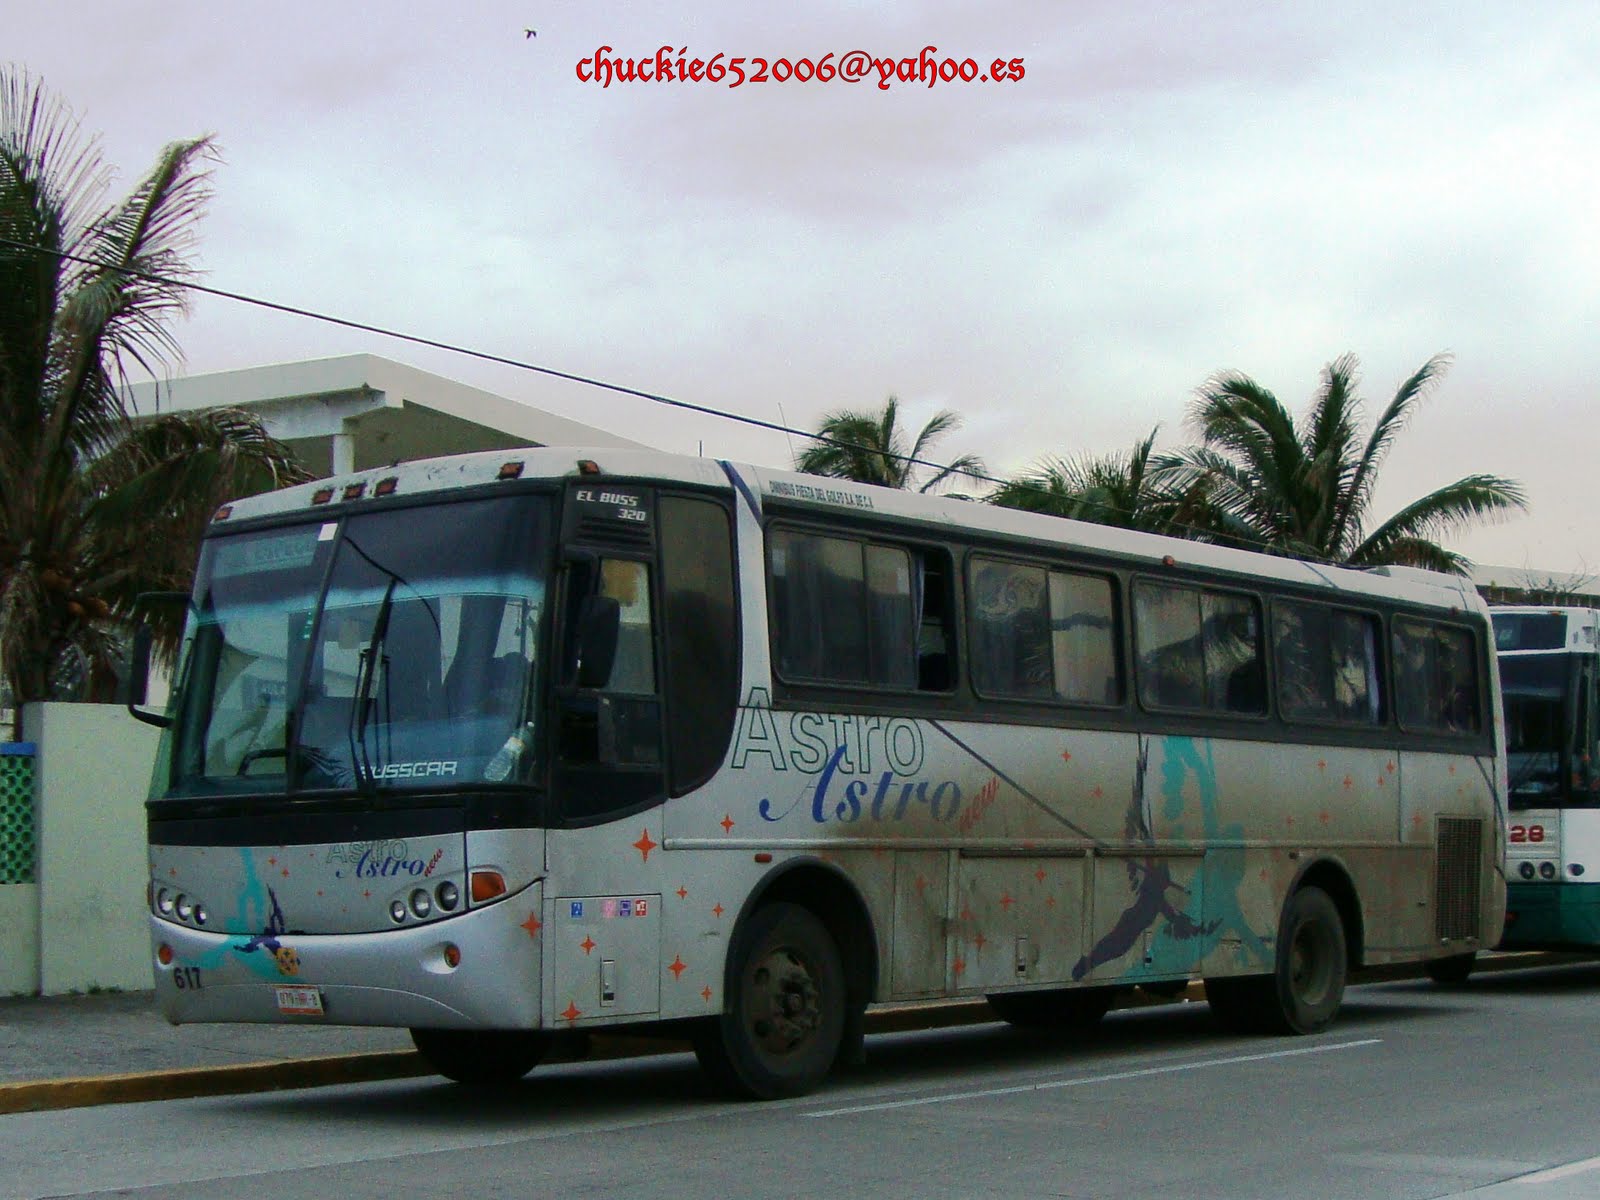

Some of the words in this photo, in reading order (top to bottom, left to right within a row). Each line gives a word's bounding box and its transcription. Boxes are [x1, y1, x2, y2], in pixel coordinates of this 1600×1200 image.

[576, 490, 596, 502] EL
[599, 492, 638, 507] BUSS
[617, 508, 646, 521] 320
[731, 687, 925, 777] Astro
[759, 743, 962, 823] Astro
[335, 848, 425, 879] Astro
[173, 966, 202, 990] 617
